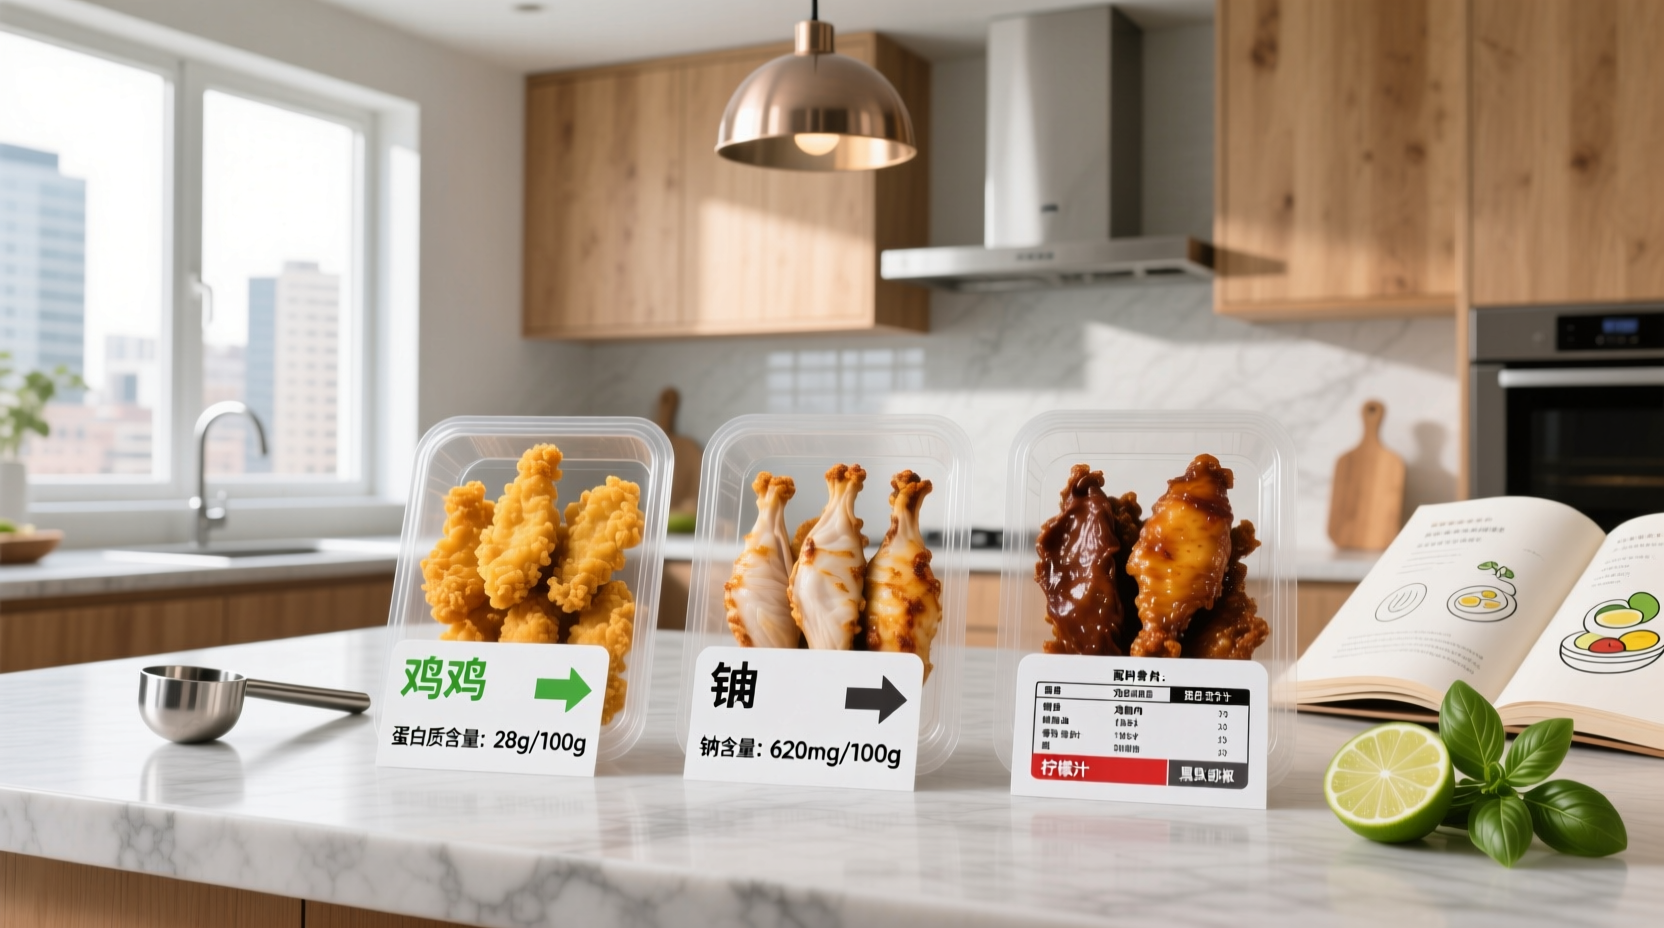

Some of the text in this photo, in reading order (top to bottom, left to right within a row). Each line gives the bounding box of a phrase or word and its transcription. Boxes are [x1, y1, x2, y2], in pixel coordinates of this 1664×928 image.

[401, 655, 487, 701] 鸡鸡
[493, 730, 587, 757] 28g/100g
[770, 739, 902, 769] 620mg/100g
